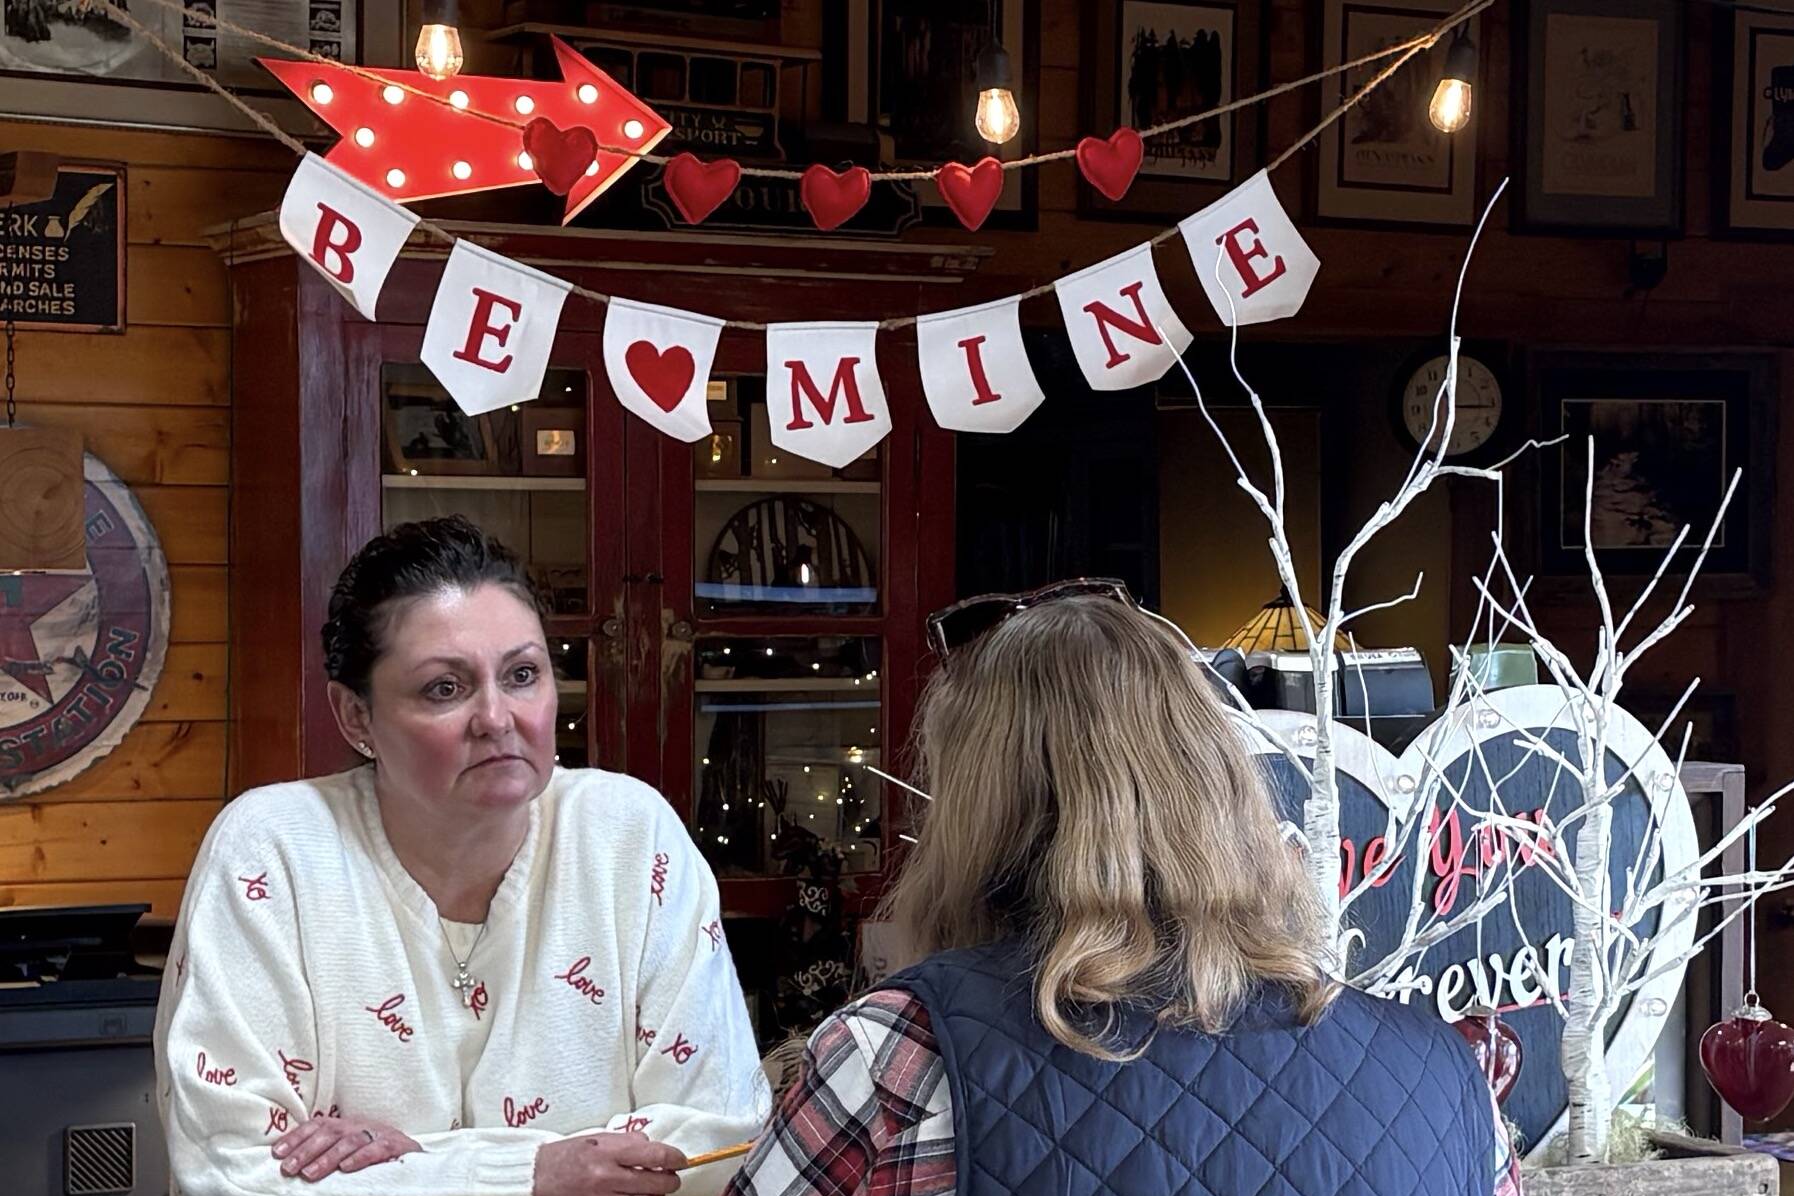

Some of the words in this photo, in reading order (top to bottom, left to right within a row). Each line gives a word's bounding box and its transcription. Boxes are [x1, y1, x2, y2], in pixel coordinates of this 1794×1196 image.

[28, 281, 76, 299] SALE
[784, 217, 1287, 431] MINE
[555, 956, 605, 1005] love
[365, 993, 414, 1043] love
[197, 1051, 238, 1086] love
[503, 1096, 549, 1128] love
